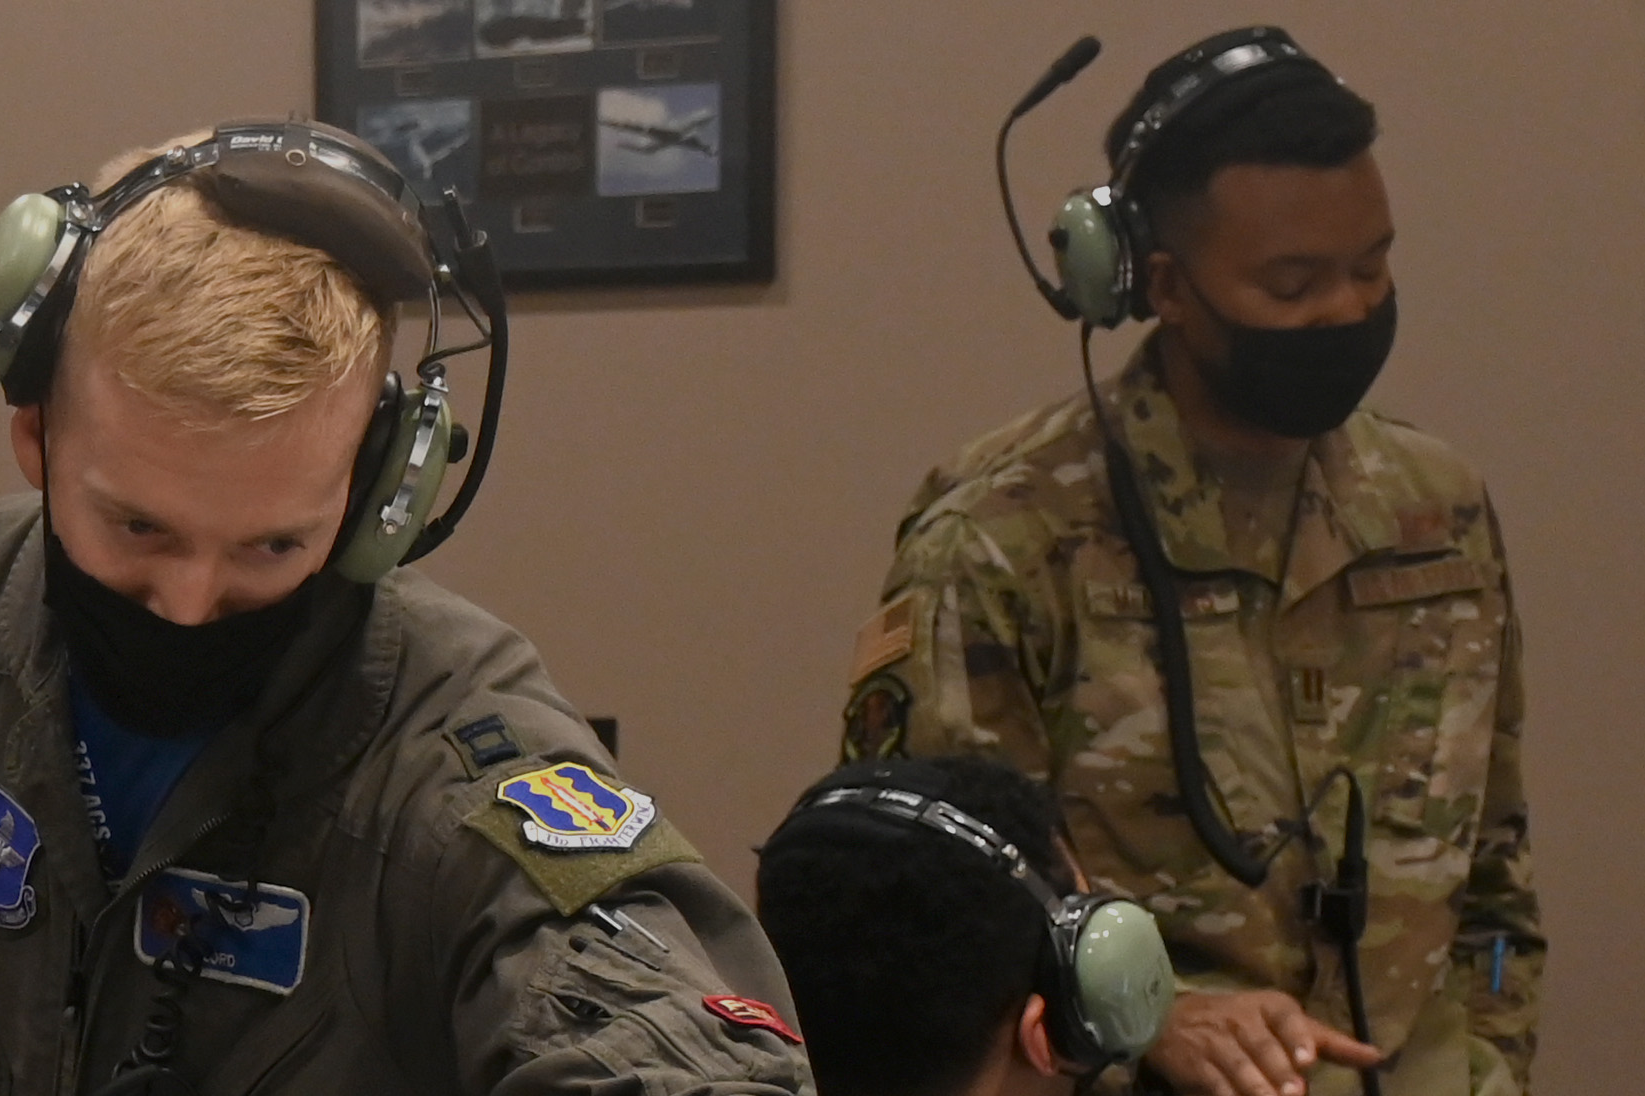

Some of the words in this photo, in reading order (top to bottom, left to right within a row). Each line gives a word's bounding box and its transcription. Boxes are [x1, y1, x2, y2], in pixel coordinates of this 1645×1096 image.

[230, 135, 274, 145] David
[75, 740, 96, 785] 337
[82, 794, 112, 840] ACS
[579, 823, 638, 847] FIGHTER
[630, 802, 651, 825] WIN
